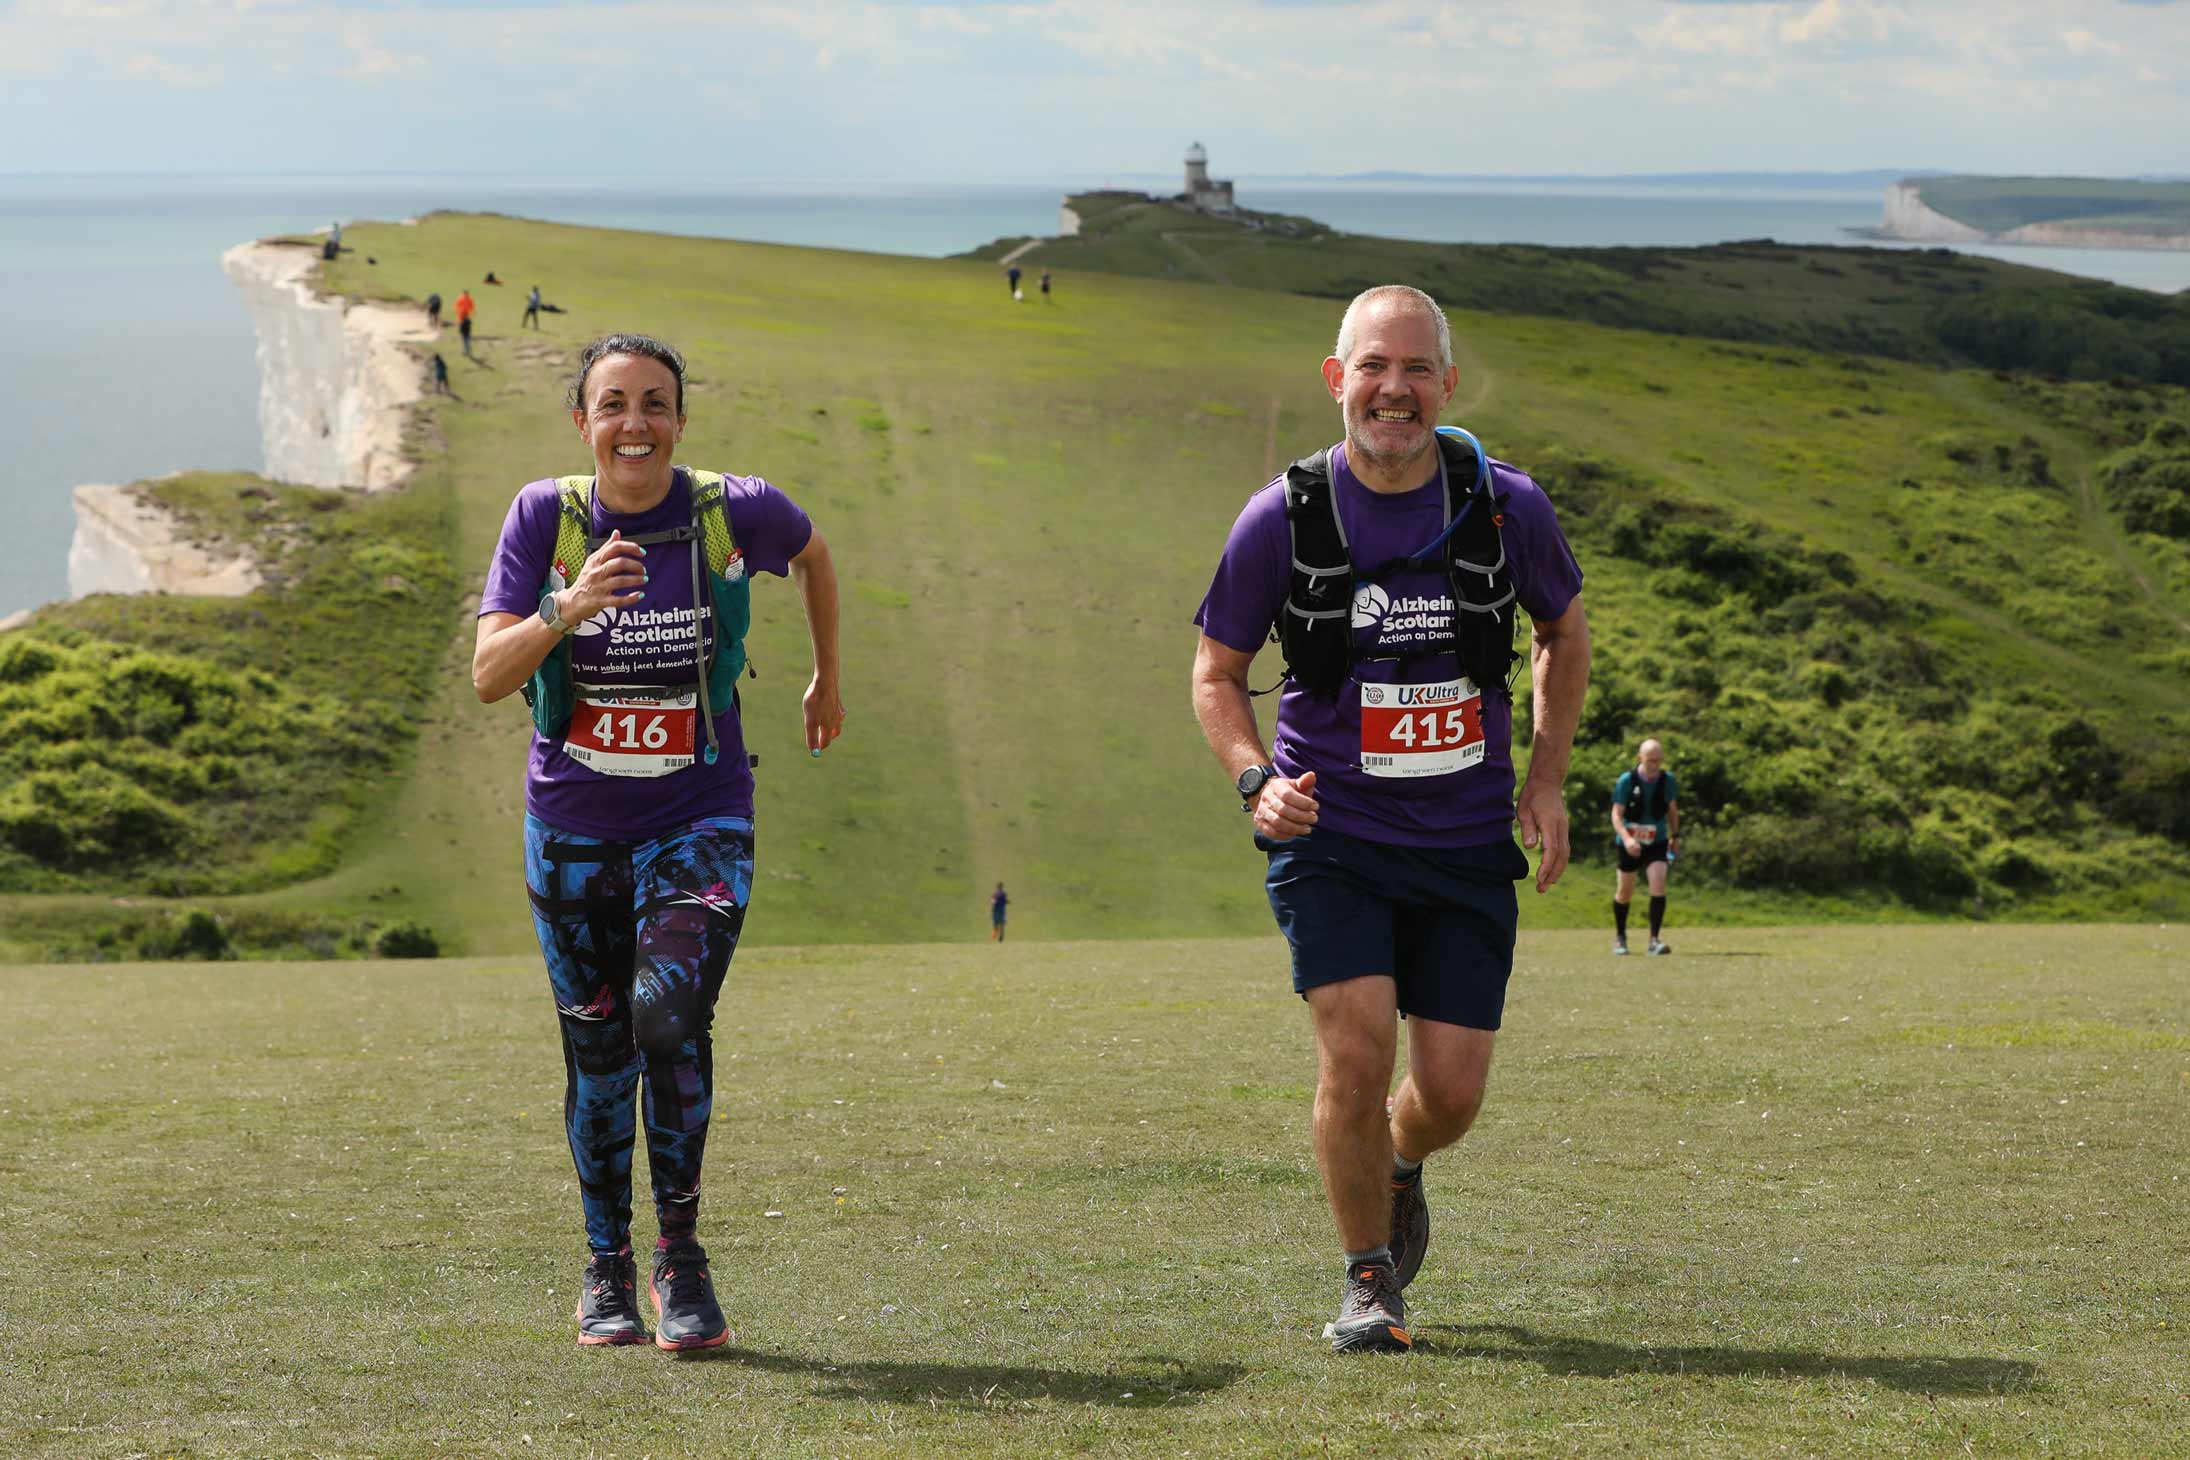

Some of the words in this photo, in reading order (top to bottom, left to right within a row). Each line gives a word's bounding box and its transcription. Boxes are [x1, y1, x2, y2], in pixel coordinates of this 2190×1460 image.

[1382, 613, 1455, 632] Scotlan
[1378, 633, 1412, 645] Action
[1415, 632, 1426, 641] on
[605, 646, 643, 656] Action
[645, 646, 660, 654] on
[600, 661, 630, 674] nobody
[633, 661, 654, 672] faces
[656, 657, 693, 669] dementia
[592, 712, 668, 749] 416
[1389, 708, 1465, 747] 415
